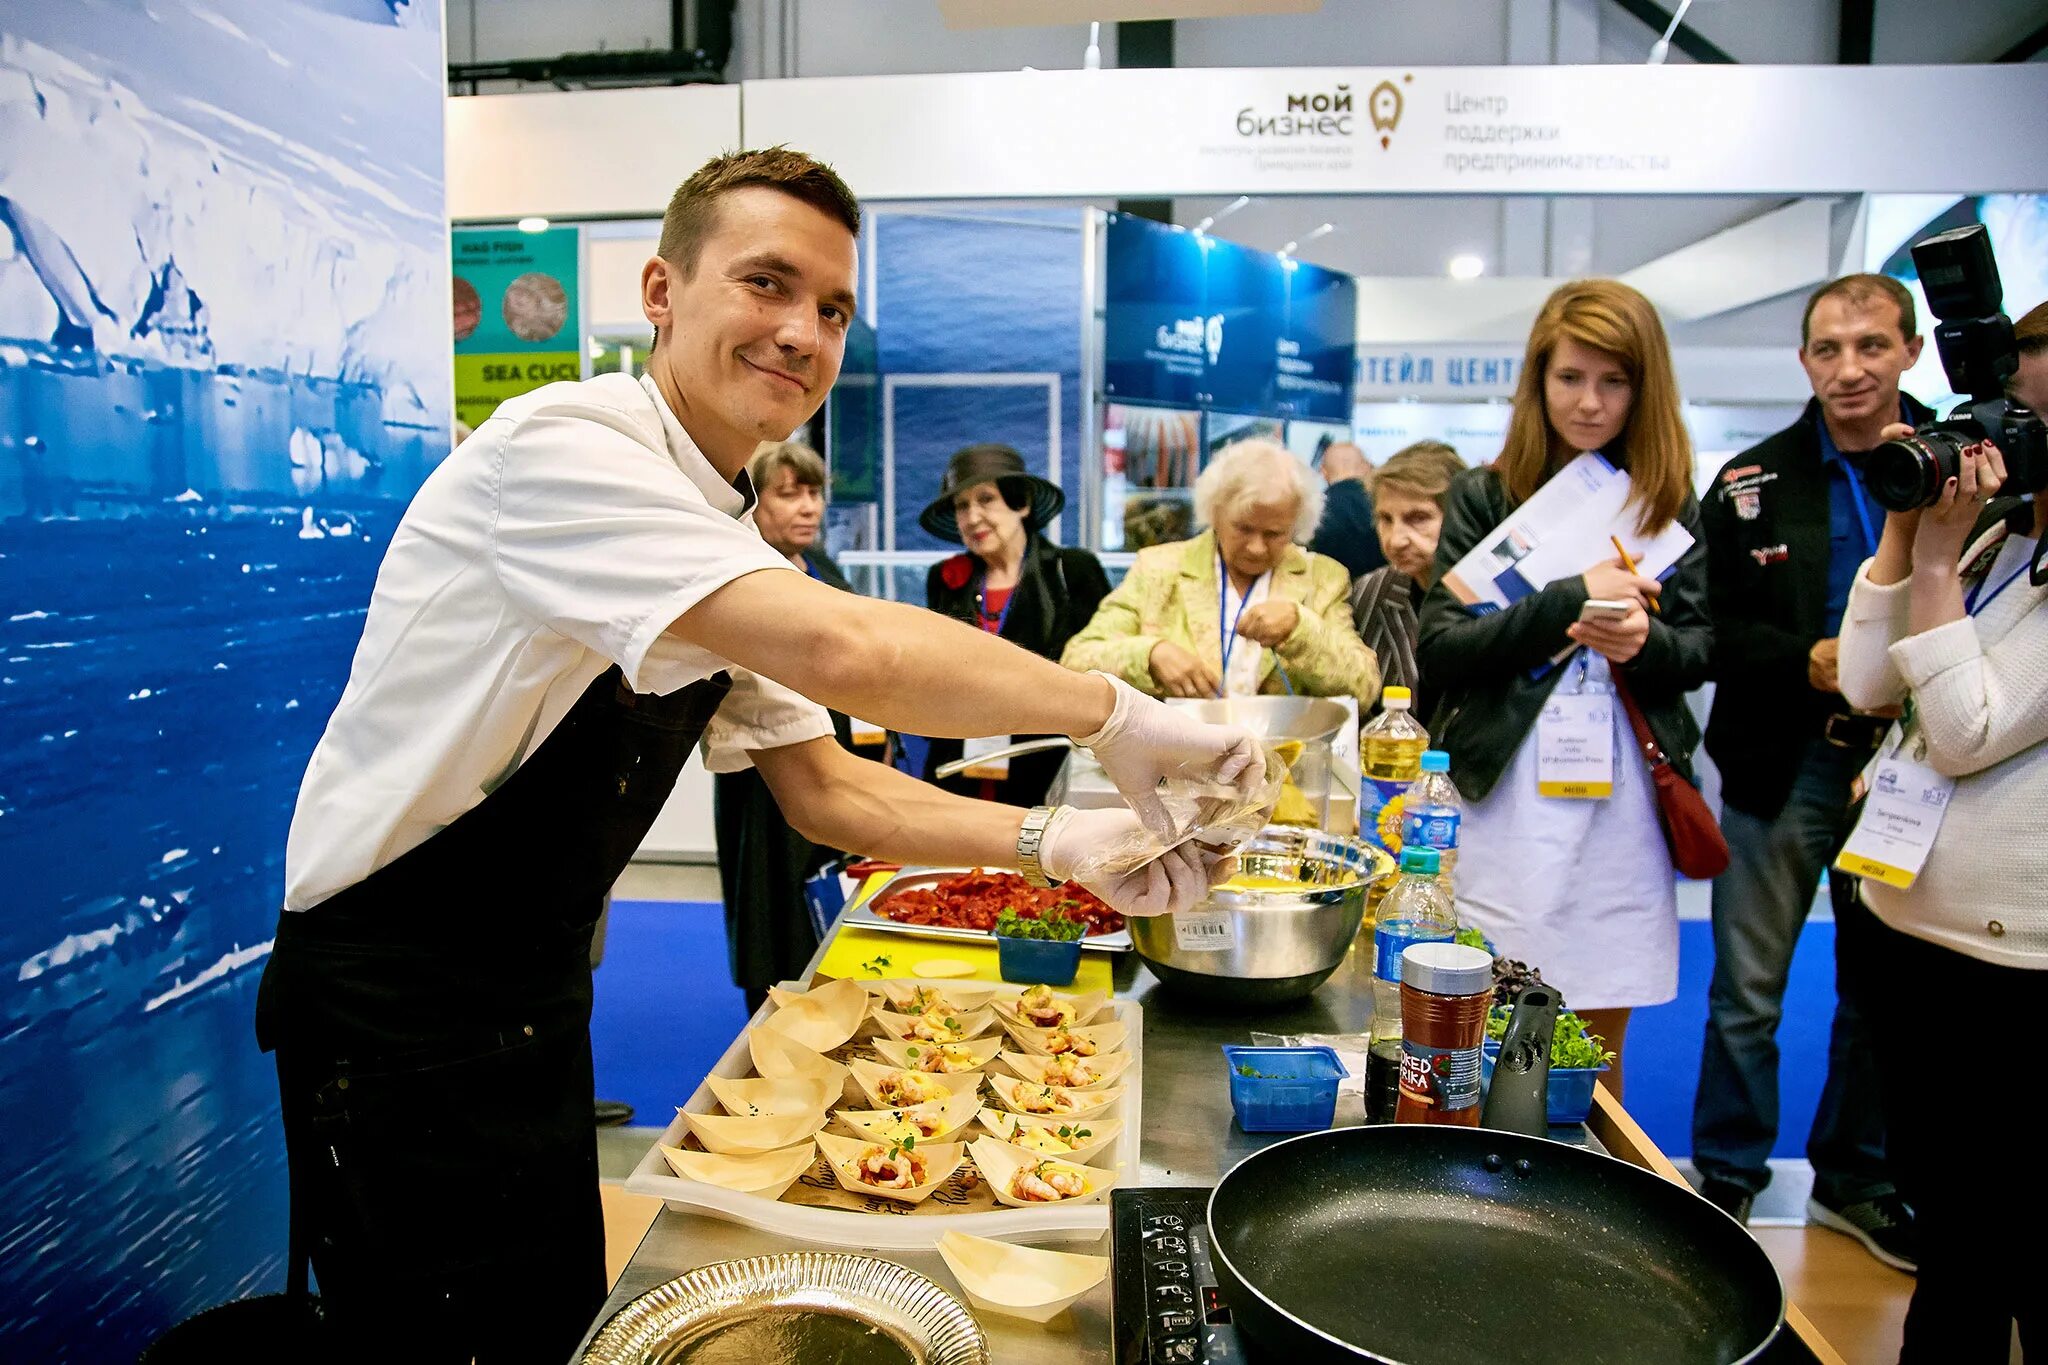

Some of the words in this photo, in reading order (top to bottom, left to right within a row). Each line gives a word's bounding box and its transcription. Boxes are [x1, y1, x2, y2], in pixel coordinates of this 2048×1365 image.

[1288, 84, 1352, 112] мой
[1444, 92, 1508, 115] Центр
[1236, 107, 1353, 137] бизнес
[1444, 124, 1561, 145] поддержки
[482, 364, 521, 382] SEA
[1401, 1049, 1431, 1074] OKED
[1401, 1065, 1428, 1089] RIKA
